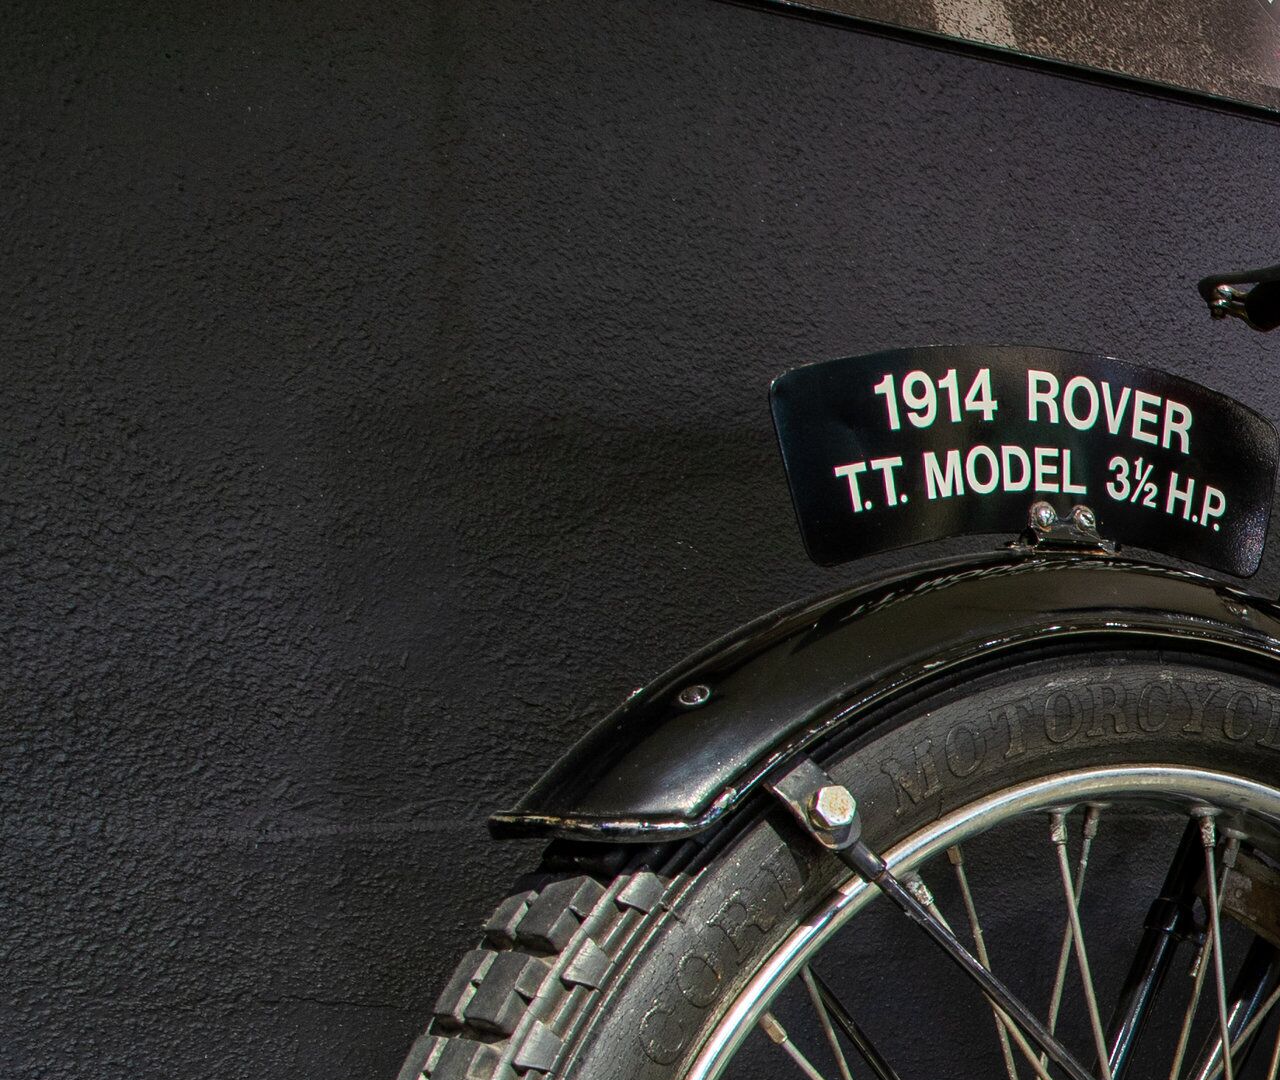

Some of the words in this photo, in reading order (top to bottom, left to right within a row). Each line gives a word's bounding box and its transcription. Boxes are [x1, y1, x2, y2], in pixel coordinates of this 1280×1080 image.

[874, 367, 998, 431] 1914
[1028, 369, 1194, 455] ROVER
[834, 456, 908, 514] T.T.
[924, 445, 1087, 500] MODEL
[1106, 455, 1158, 510] 3½
[1166, 477, 1227, 533] H.P.
